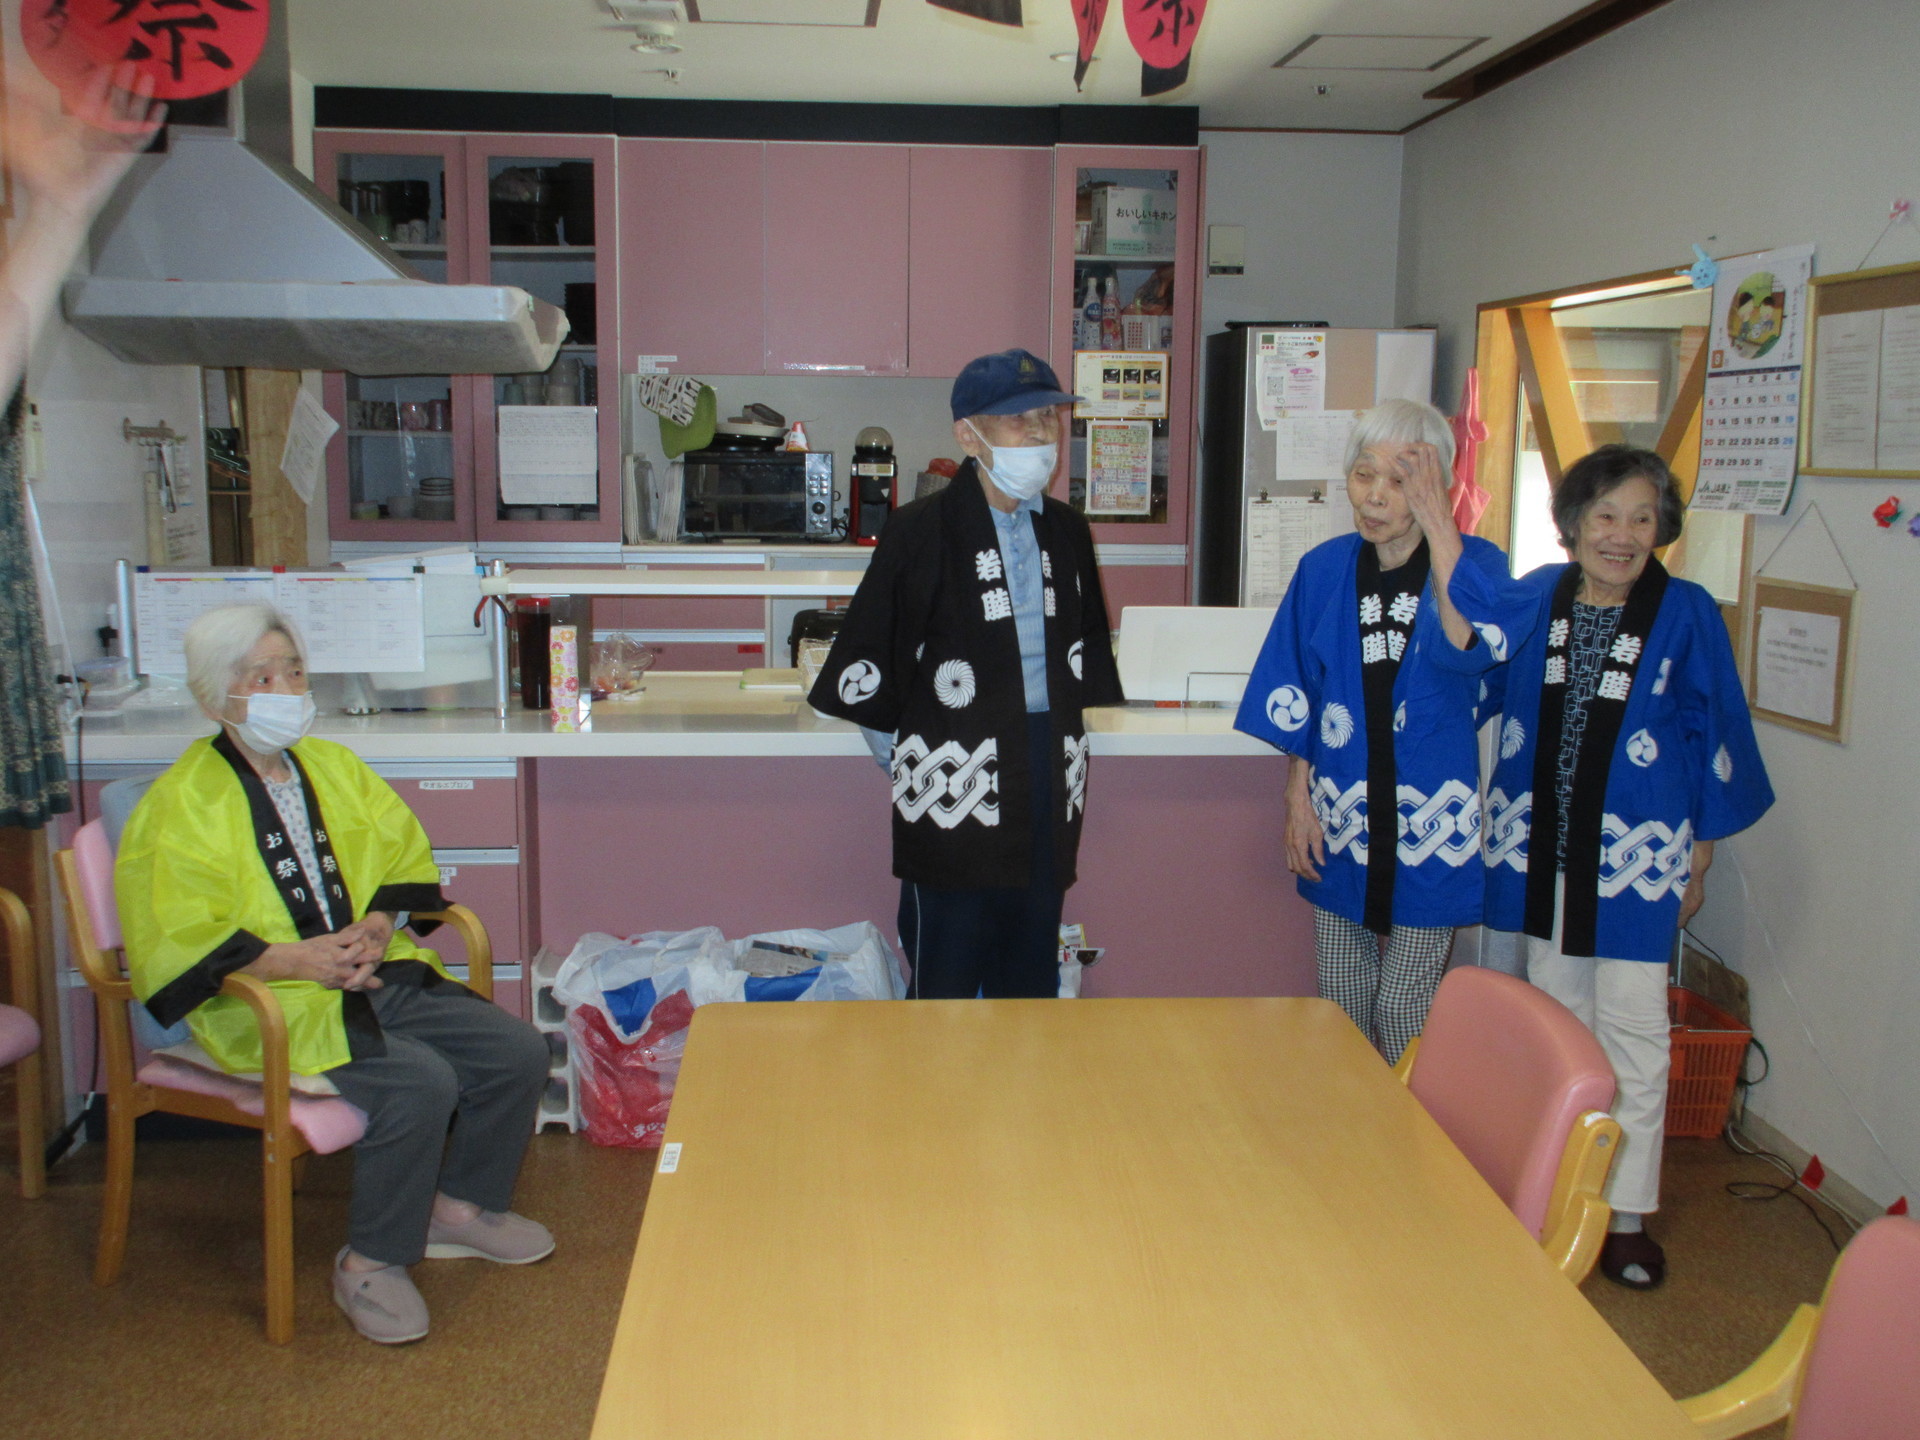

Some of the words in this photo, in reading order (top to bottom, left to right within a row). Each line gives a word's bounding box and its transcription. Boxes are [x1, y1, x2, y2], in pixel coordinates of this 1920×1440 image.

[1116, 208, 1177, 221] おいしいキホン
[265, 832, 306, 903] お祭り
[315, 828, 343, 900] お祭り
